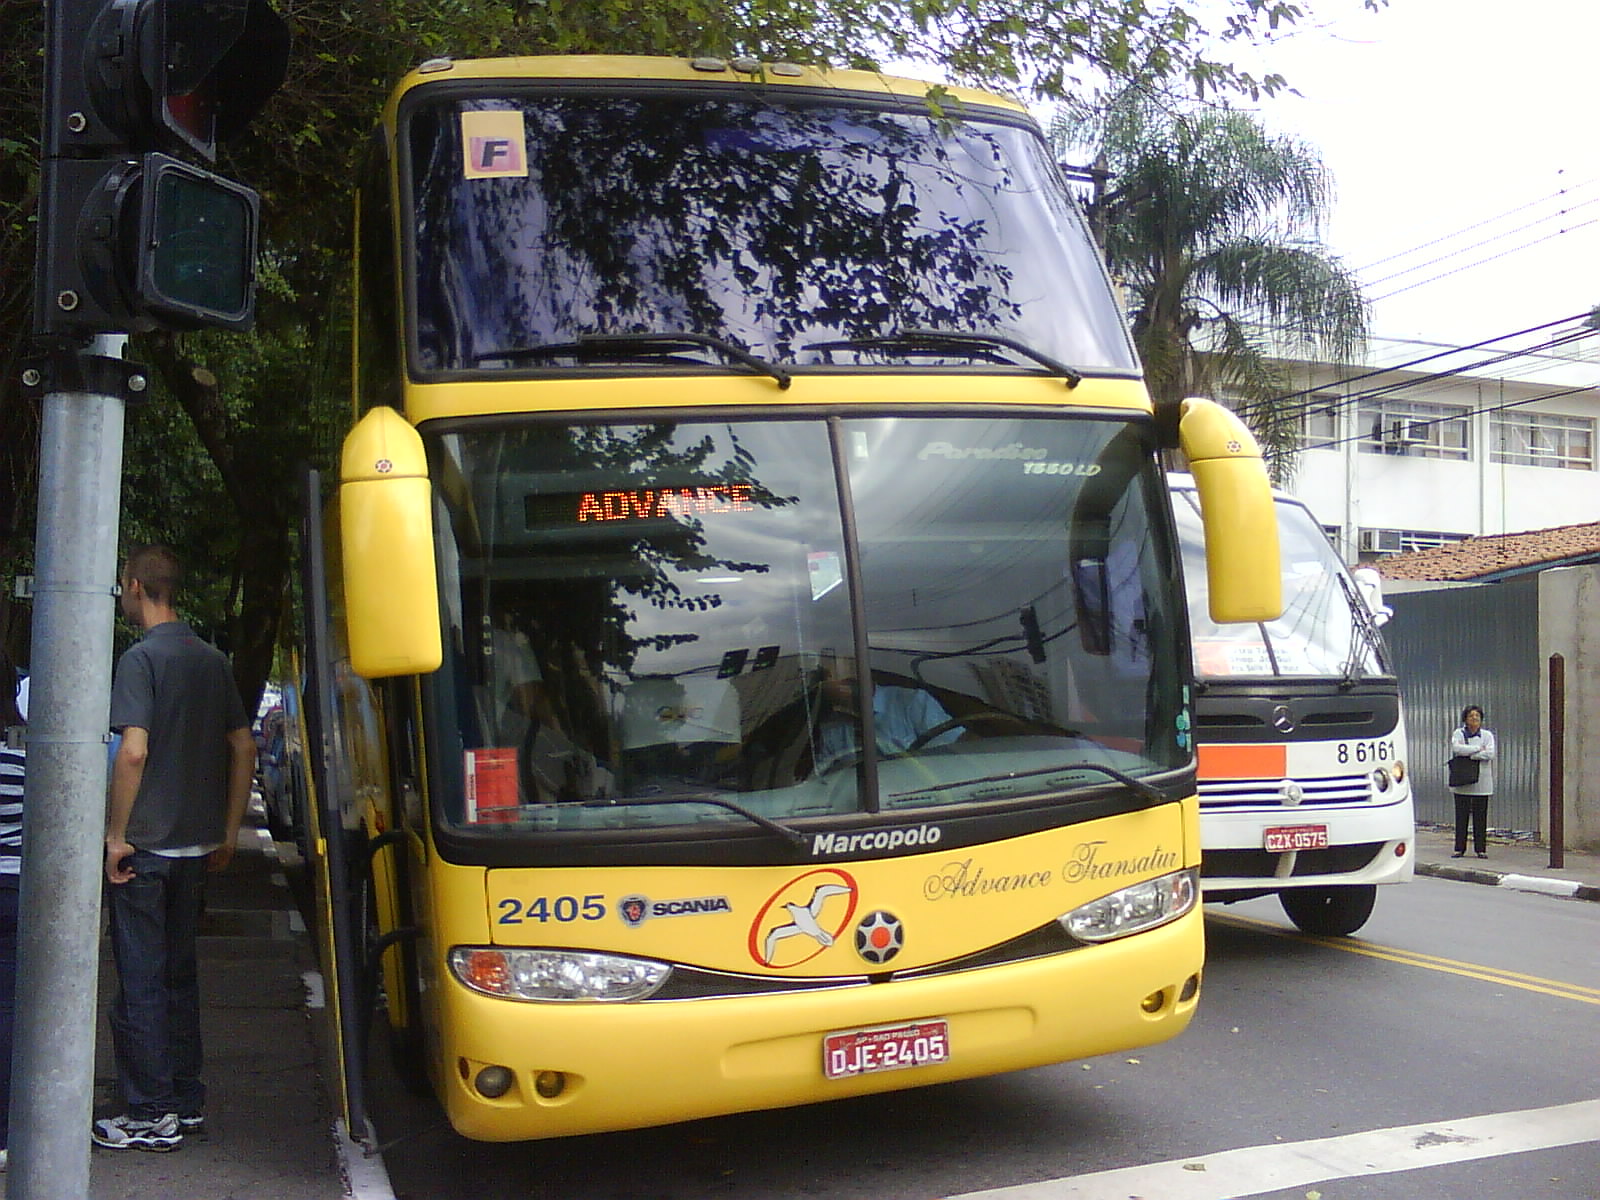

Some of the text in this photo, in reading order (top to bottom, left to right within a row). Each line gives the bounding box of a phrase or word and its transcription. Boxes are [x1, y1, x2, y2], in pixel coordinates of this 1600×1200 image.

[481, 140, 509, 168] F
[577, 484, 754, 522] ADVANCE
[812, 825, 941, 855] Marcopolo
[923, 841, 1177, 902] Advance Transatur
[498, 895, 607, 925] 2405
[652, 898, 730, 916] SCANIA
[831, 1035, 945, 1074] DJE-2405
